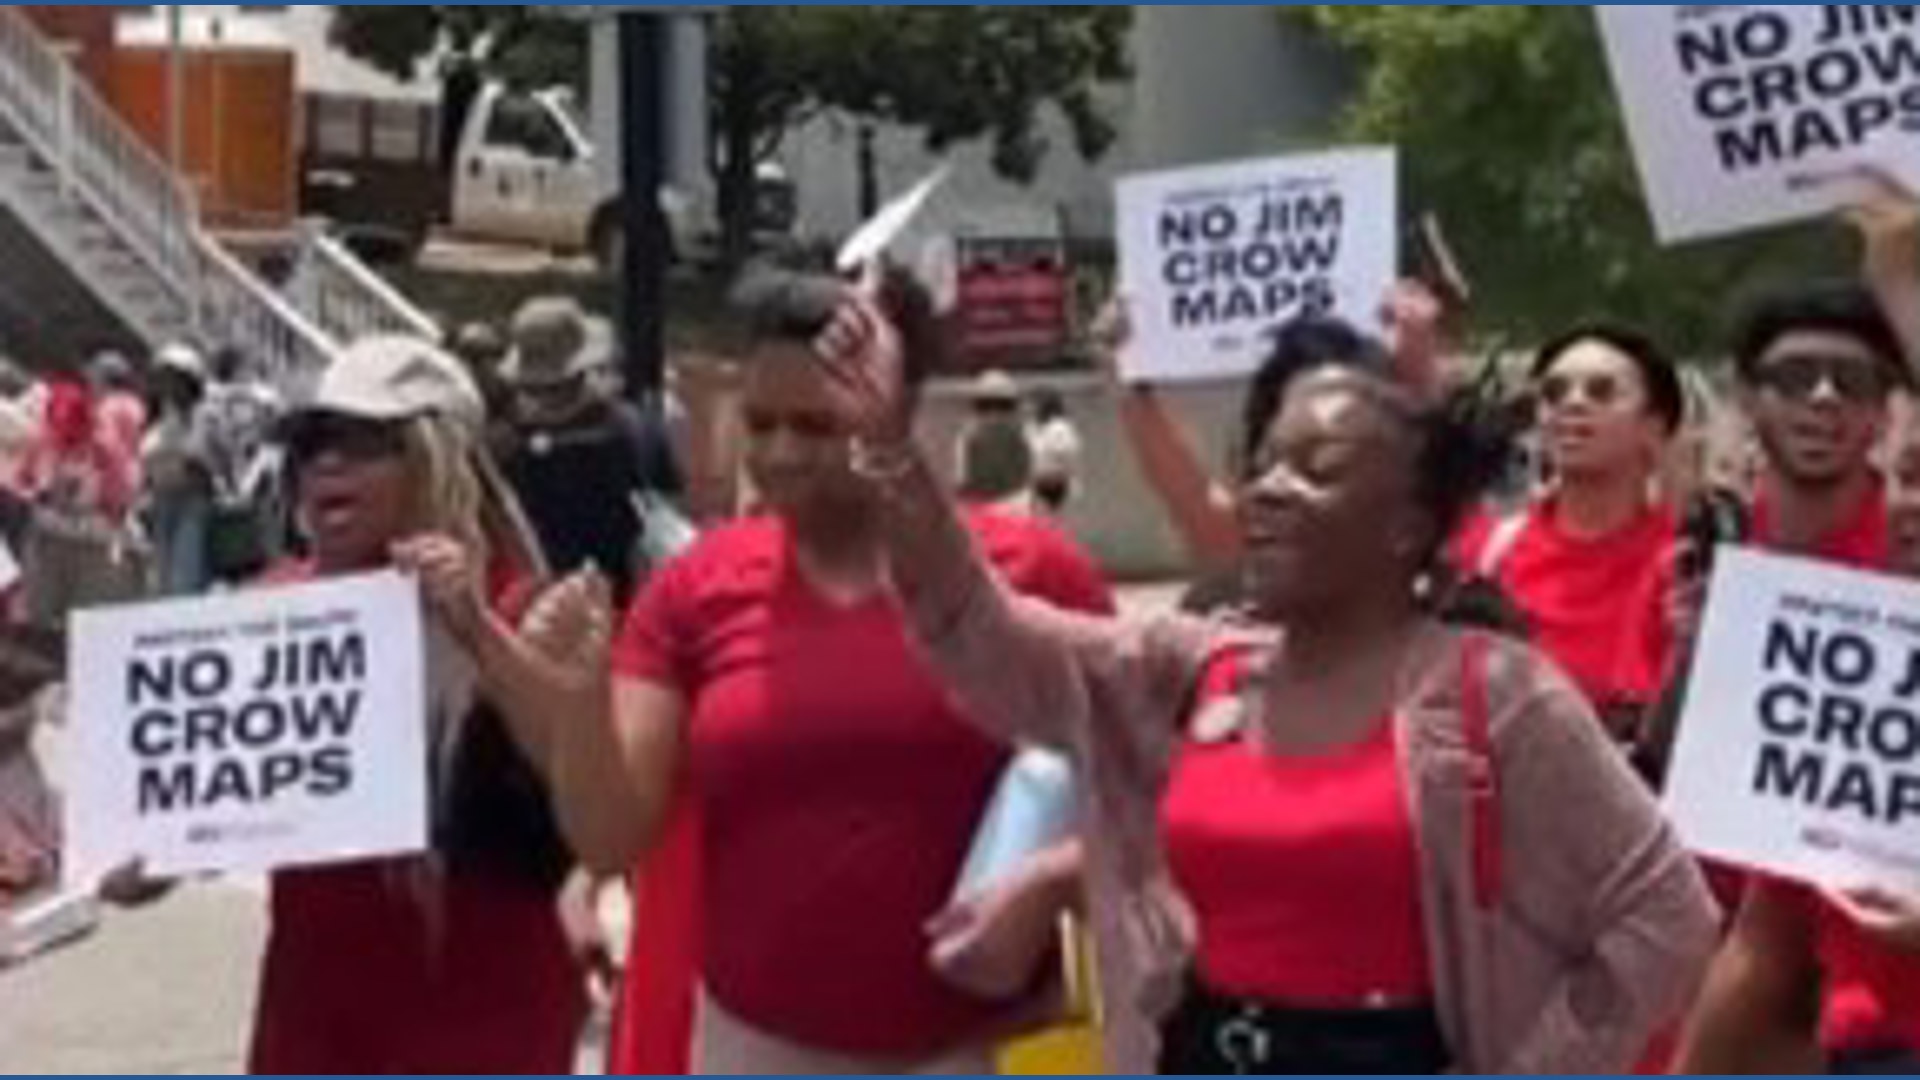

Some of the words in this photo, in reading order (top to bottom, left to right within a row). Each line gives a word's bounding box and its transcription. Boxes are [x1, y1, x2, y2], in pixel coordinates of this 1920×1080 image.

[1676, 12, 1790, 75] NO
[1158, 204, 1238, 248] NO
[1254, 191, 1343, 241] JIM
[1162, 234, 1338, 287] CROW
[1171, 277, 1336, 328] MAPS
[127, 649, 232, 704] NO
[252, 632, 367, 692] JIM
[1764, 620, 1876, 687] NO
[130, 689, 361, 758] CROW
[1757, 682, 1920, 761] CRO
[137, 746, 355, 816] MAPS
[1752, 742, 1920, 824] MAP
